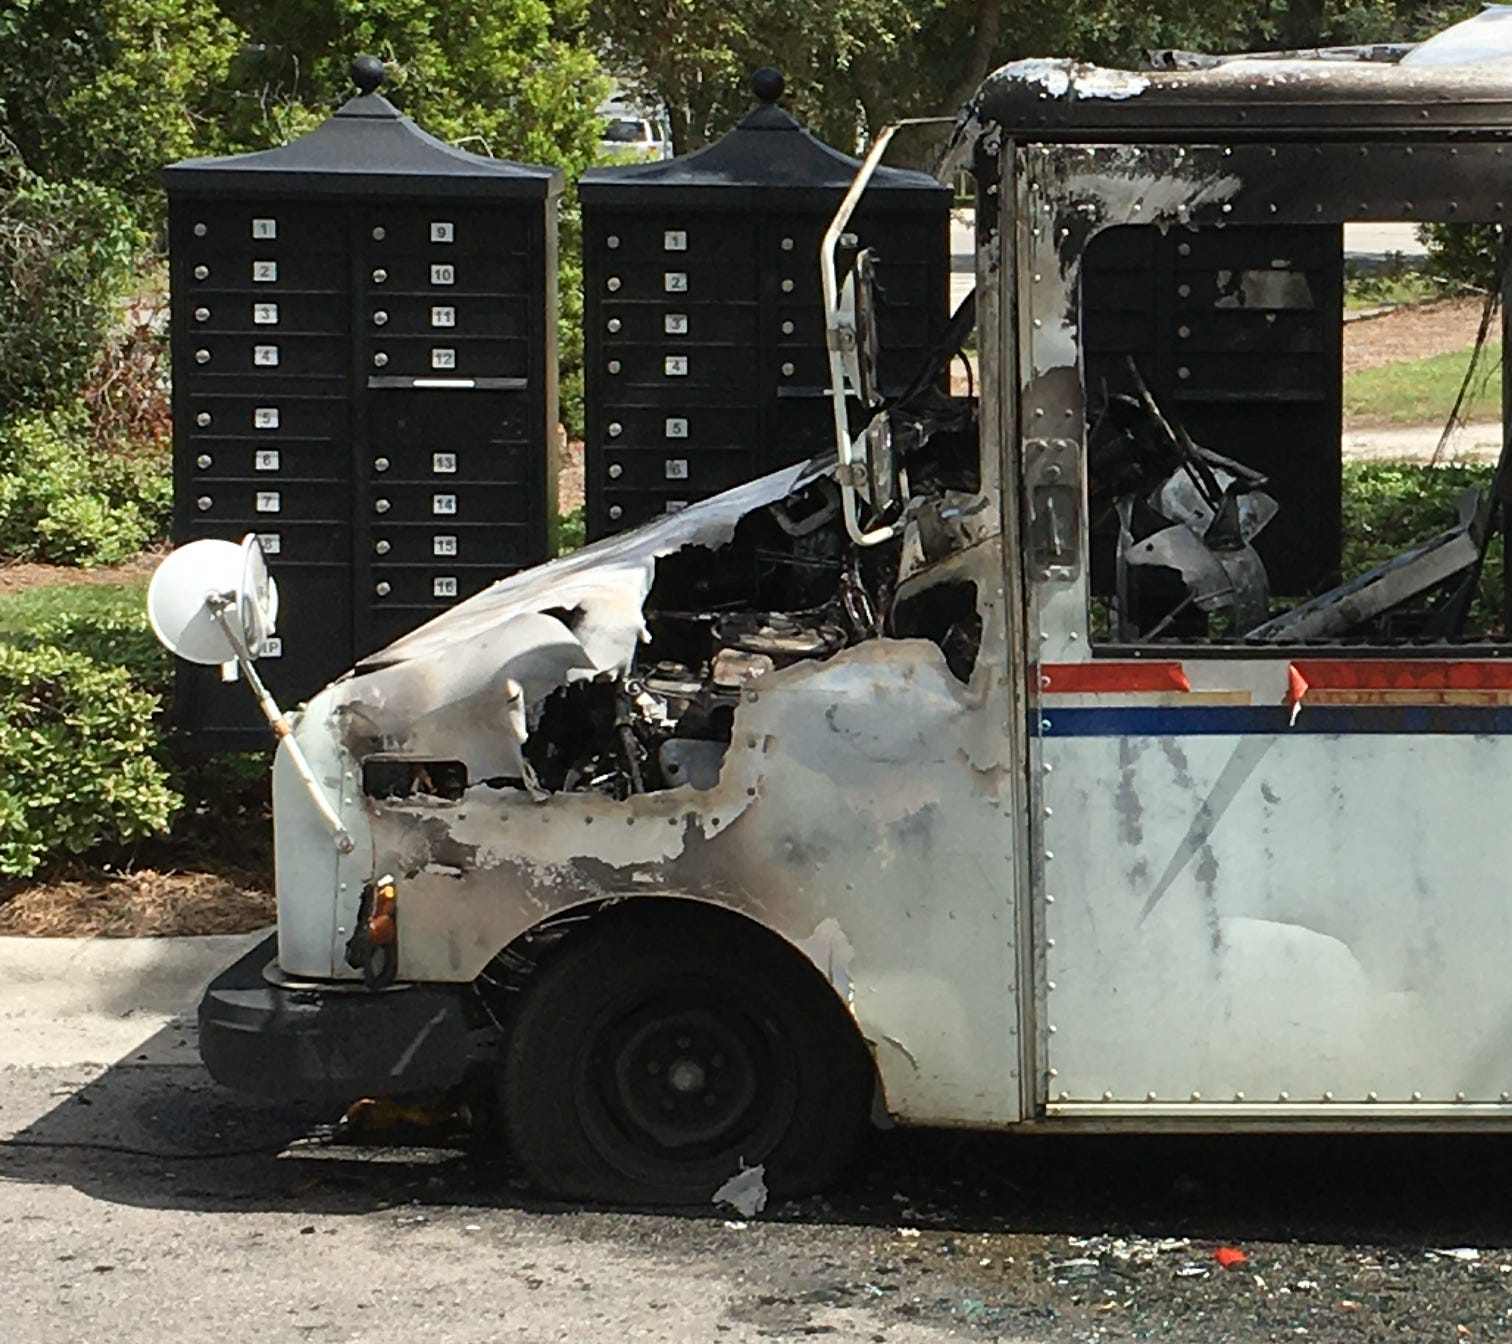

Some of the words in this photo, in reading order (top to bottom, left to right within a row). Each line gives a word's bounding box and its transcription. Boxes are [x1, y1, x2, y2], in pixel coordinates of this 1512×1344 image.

[437, 226, 447, 240] 9
[260, 265, 269, 278] 2
[434, 269, 451, 282] 10
[672, 276, 681, 289] 2
[261, 307, 270, 320] 3
[435, 310, 451, 323] 11
[672, 317, 682, 331] 3
[261, 349, 270, 362] 4
[435, 353, 453, 365] 12
[671, 360, 681, 373] 4
[262, 412, 271, 425] 5
[672, 422, 682, 435] 5
[262, 454, 272, 467] 6
[436, 457, 453, 470] 13
[263, 496, 273, 508] 7
[436, 499, 453, 512] 14
[437, 540, 454, 553] 15
[437, 581, 454, 594] 16
